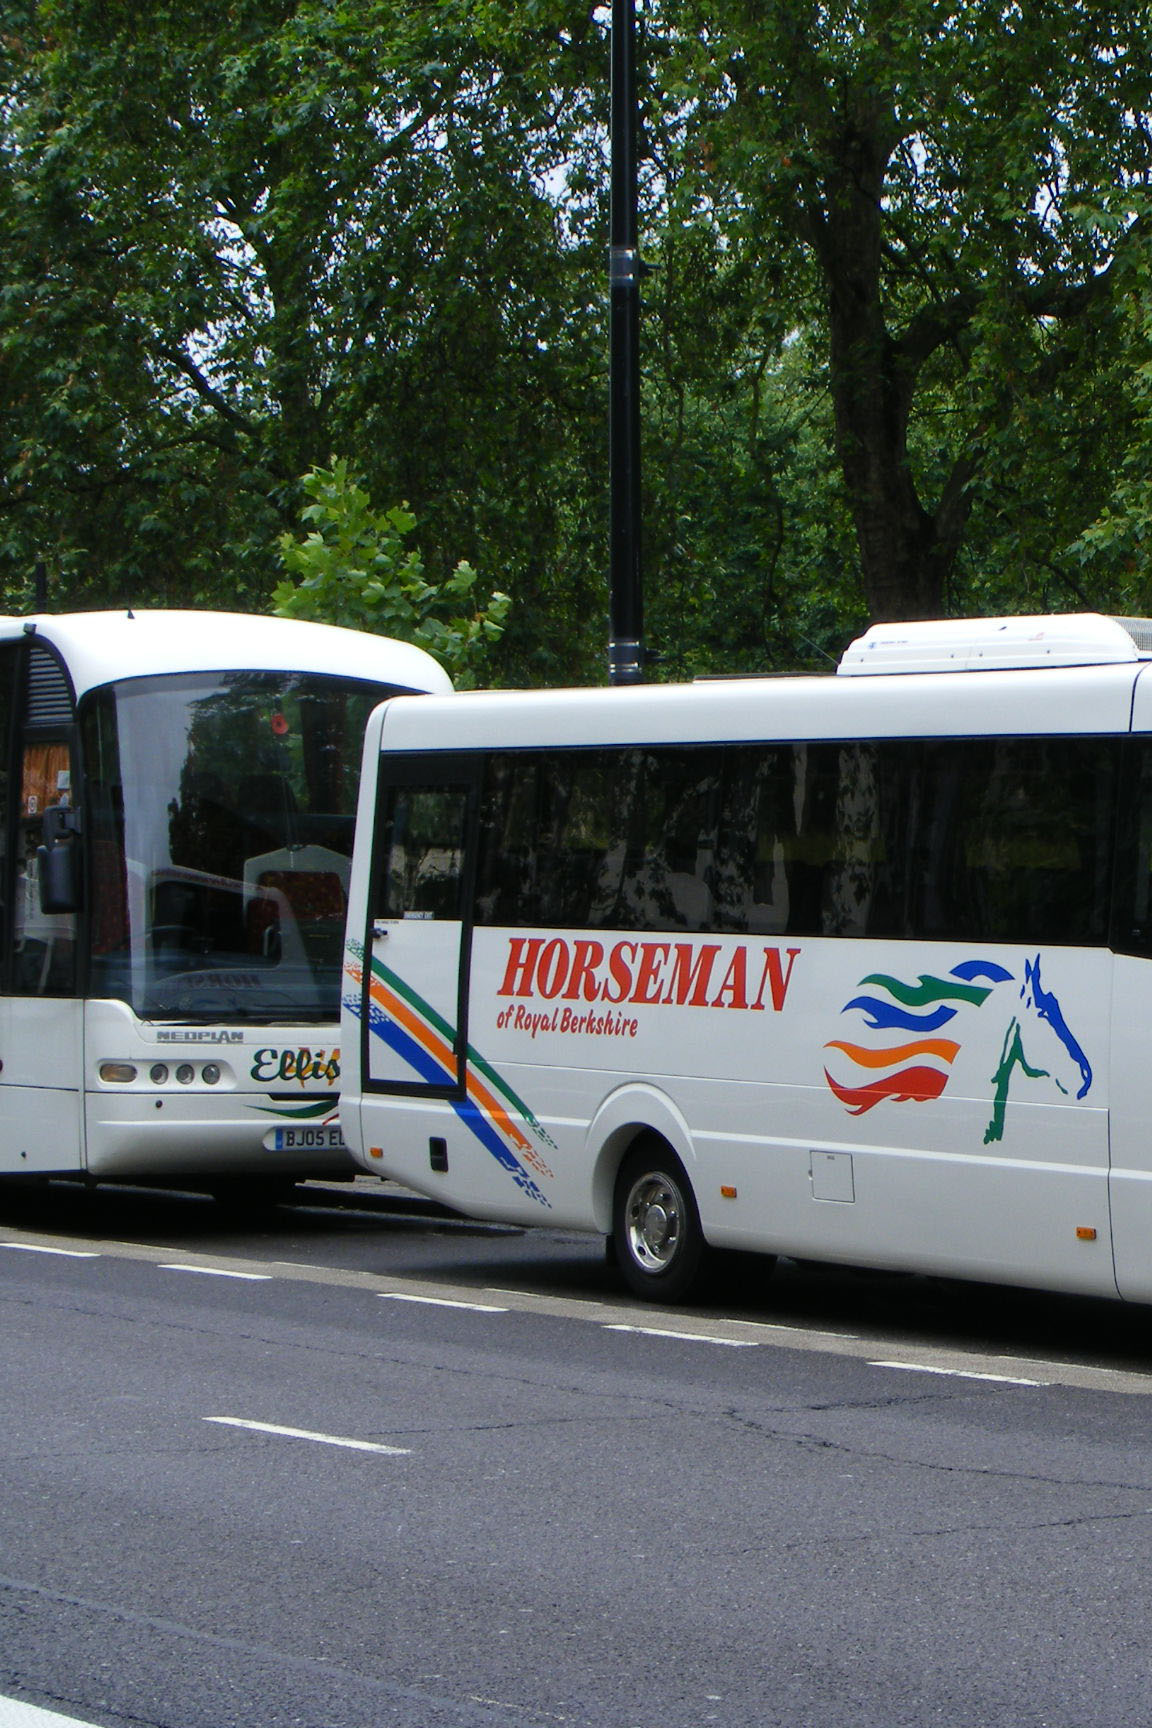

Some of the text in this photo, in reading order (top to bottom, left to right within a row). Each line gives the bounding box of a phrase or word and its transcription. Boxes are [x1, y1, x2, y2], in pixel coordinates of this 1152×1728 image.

[496, 937, 801, 1011] HORSEMAN
[156, 1031, 244, 1043] NEOPLAN
[496, 1003, 639, 1039] of Royal Berkshire
[250, 1049, 341, 1081] Ellis
[286, 1130, 345, 1146] BJ05 EL
